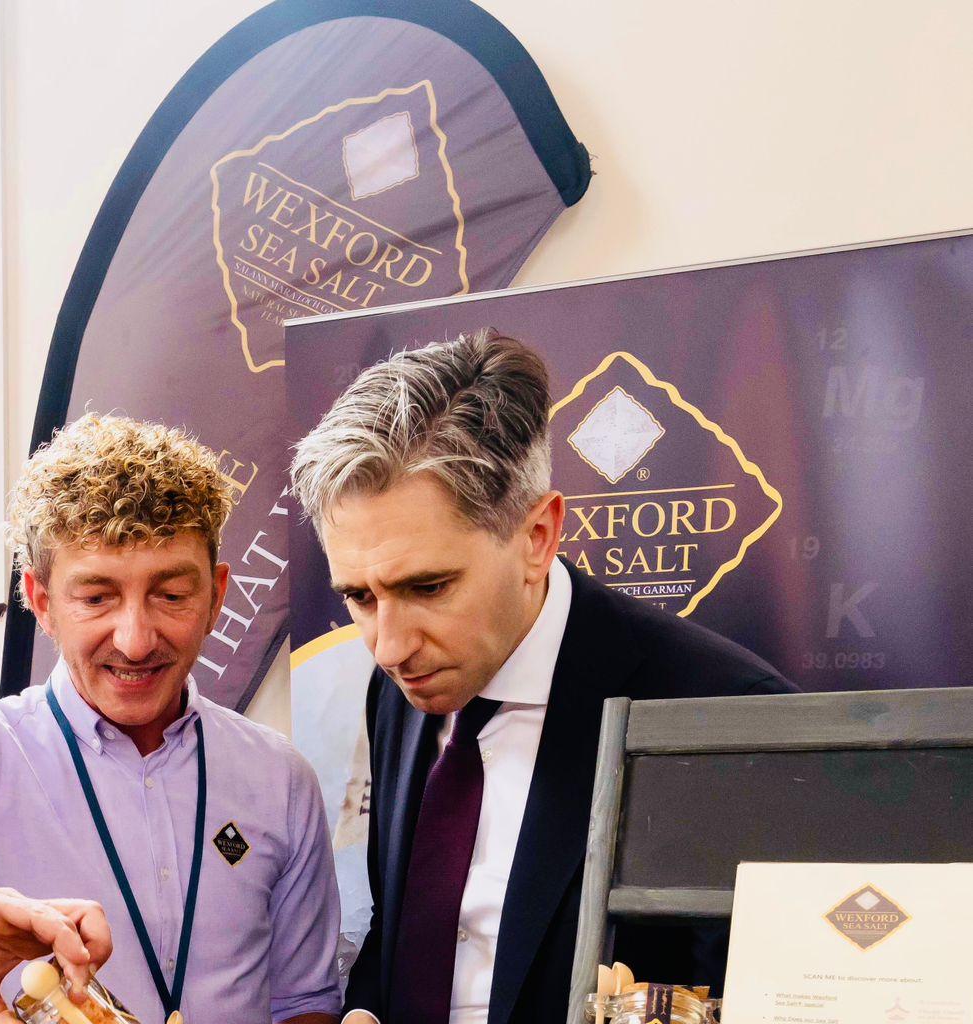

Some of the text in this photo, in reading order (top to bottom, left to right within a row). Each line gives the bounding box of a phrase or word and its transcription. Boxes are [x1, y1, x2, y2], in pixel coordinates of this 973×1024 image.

[240, 171, 433, 288] WEXFORD
[239, 223, 385, 308] SEA SALT
[559, 497, 737, 542] XFORD
[605, 543, 699, 577] SALT
[786, 535, 821, 560] 19
[642, 584, 693, 596] GARMAN
[825, 581, 881, 638] K
[801, 651, 886, 670] 39.0983
[834, 912, 900, 923] WEXFORD
[842, 922, 890, 931] SEA SALT
